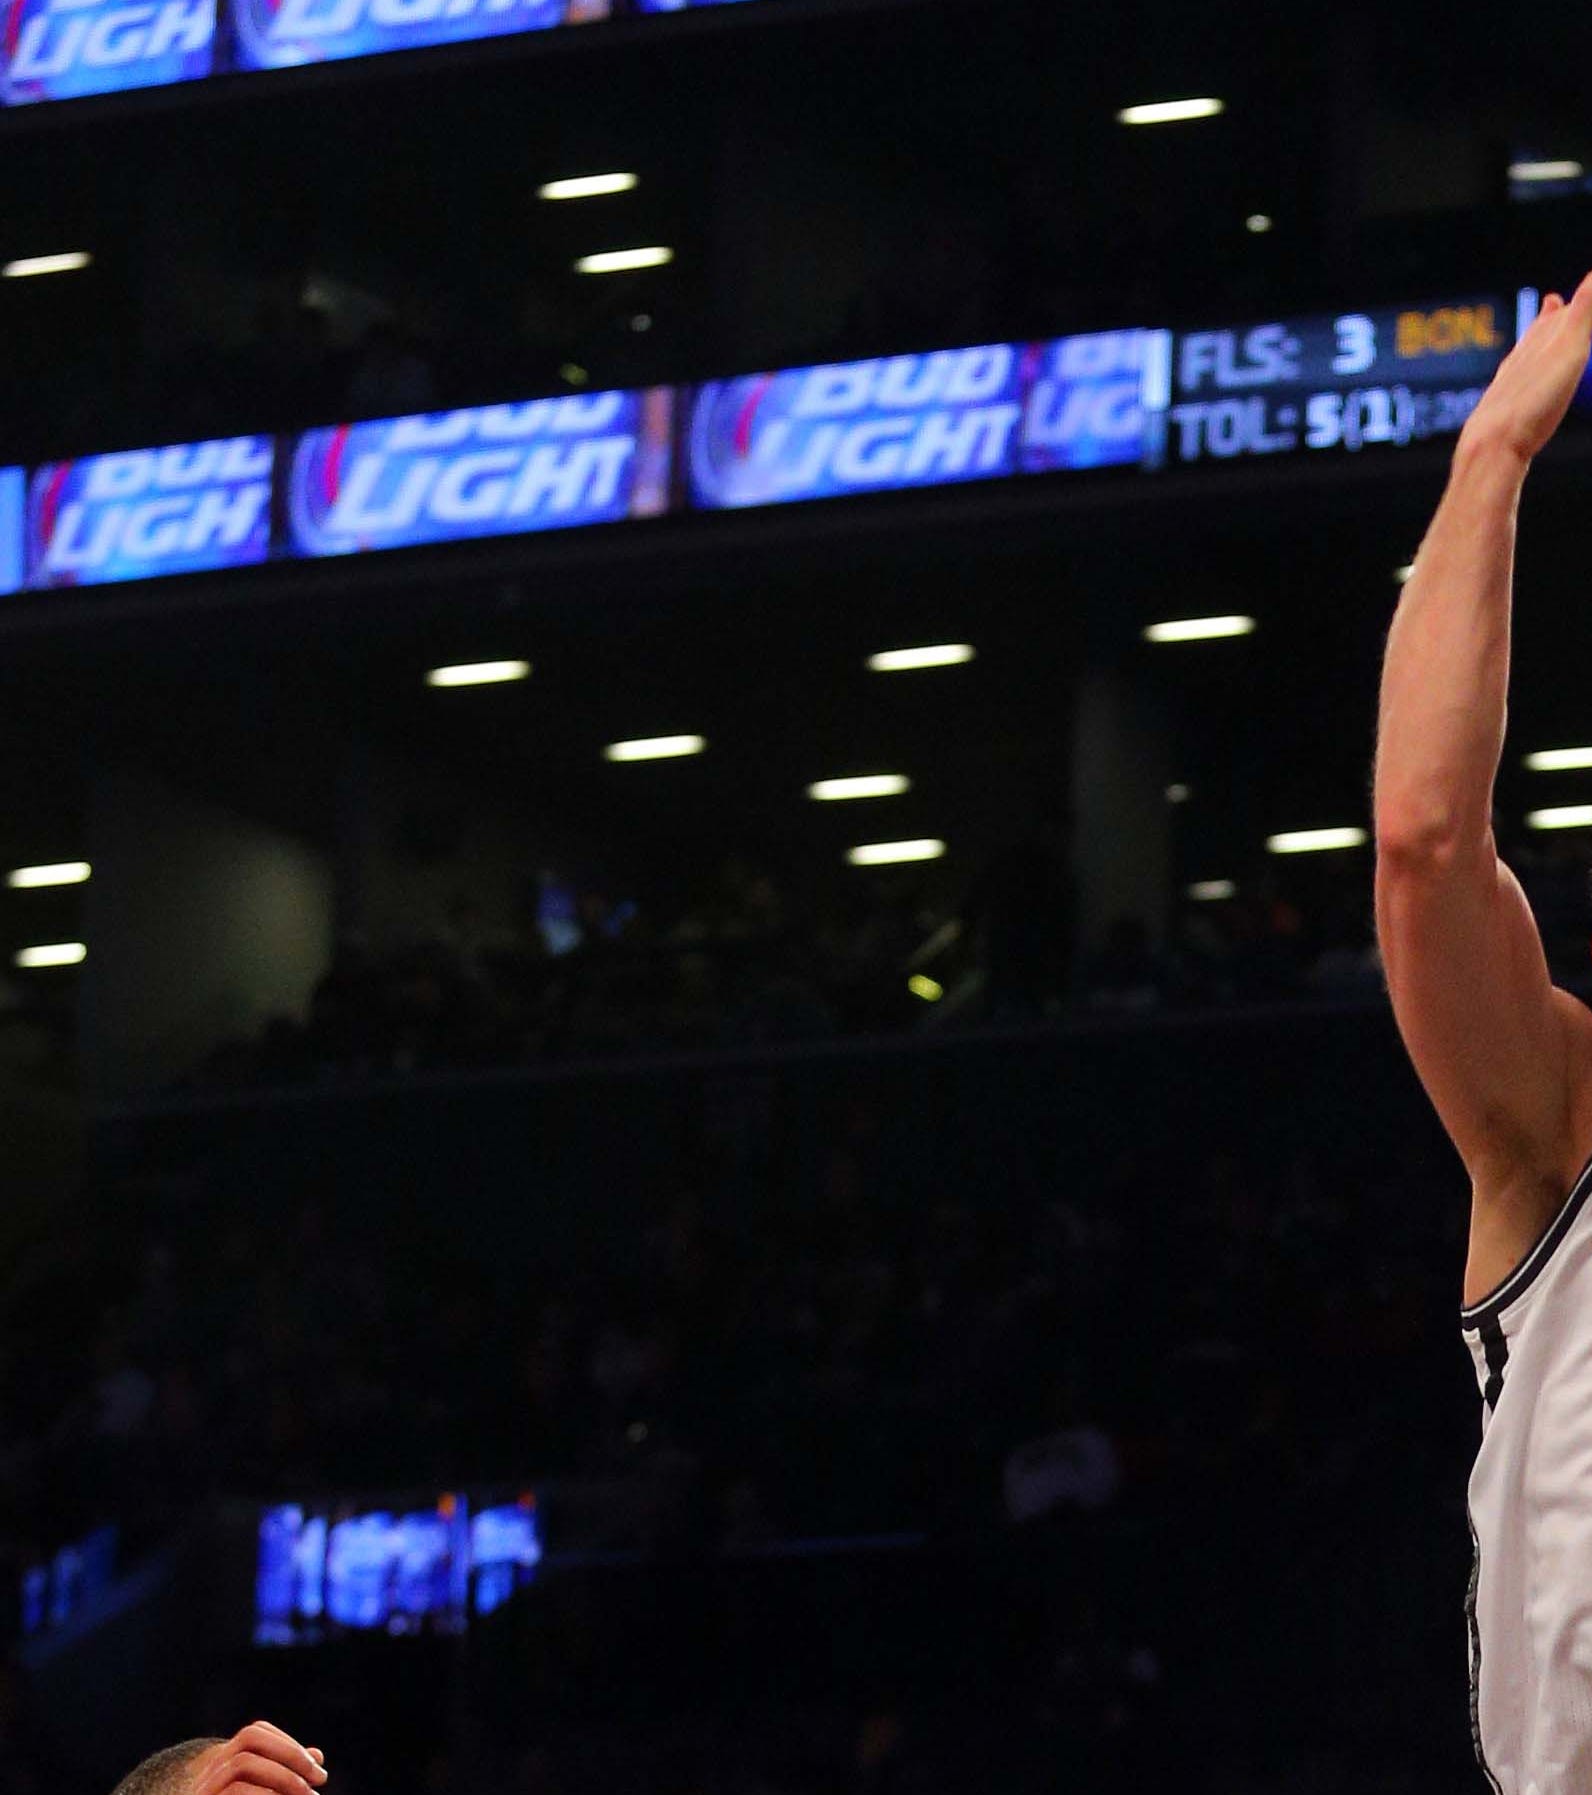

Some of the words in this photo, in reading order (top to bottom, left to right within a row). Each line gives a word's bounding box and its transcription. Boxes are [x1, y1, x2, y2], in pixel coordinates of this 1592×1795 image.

[1179, 323, 1299, 392] FLS:
[1332, 313, 1377, 376] 3
[728, 401, 1020, 495] LIGHT
[1171, 396, 1297, 461] TOL:
[322, 435, 636, 532] LIGHT
